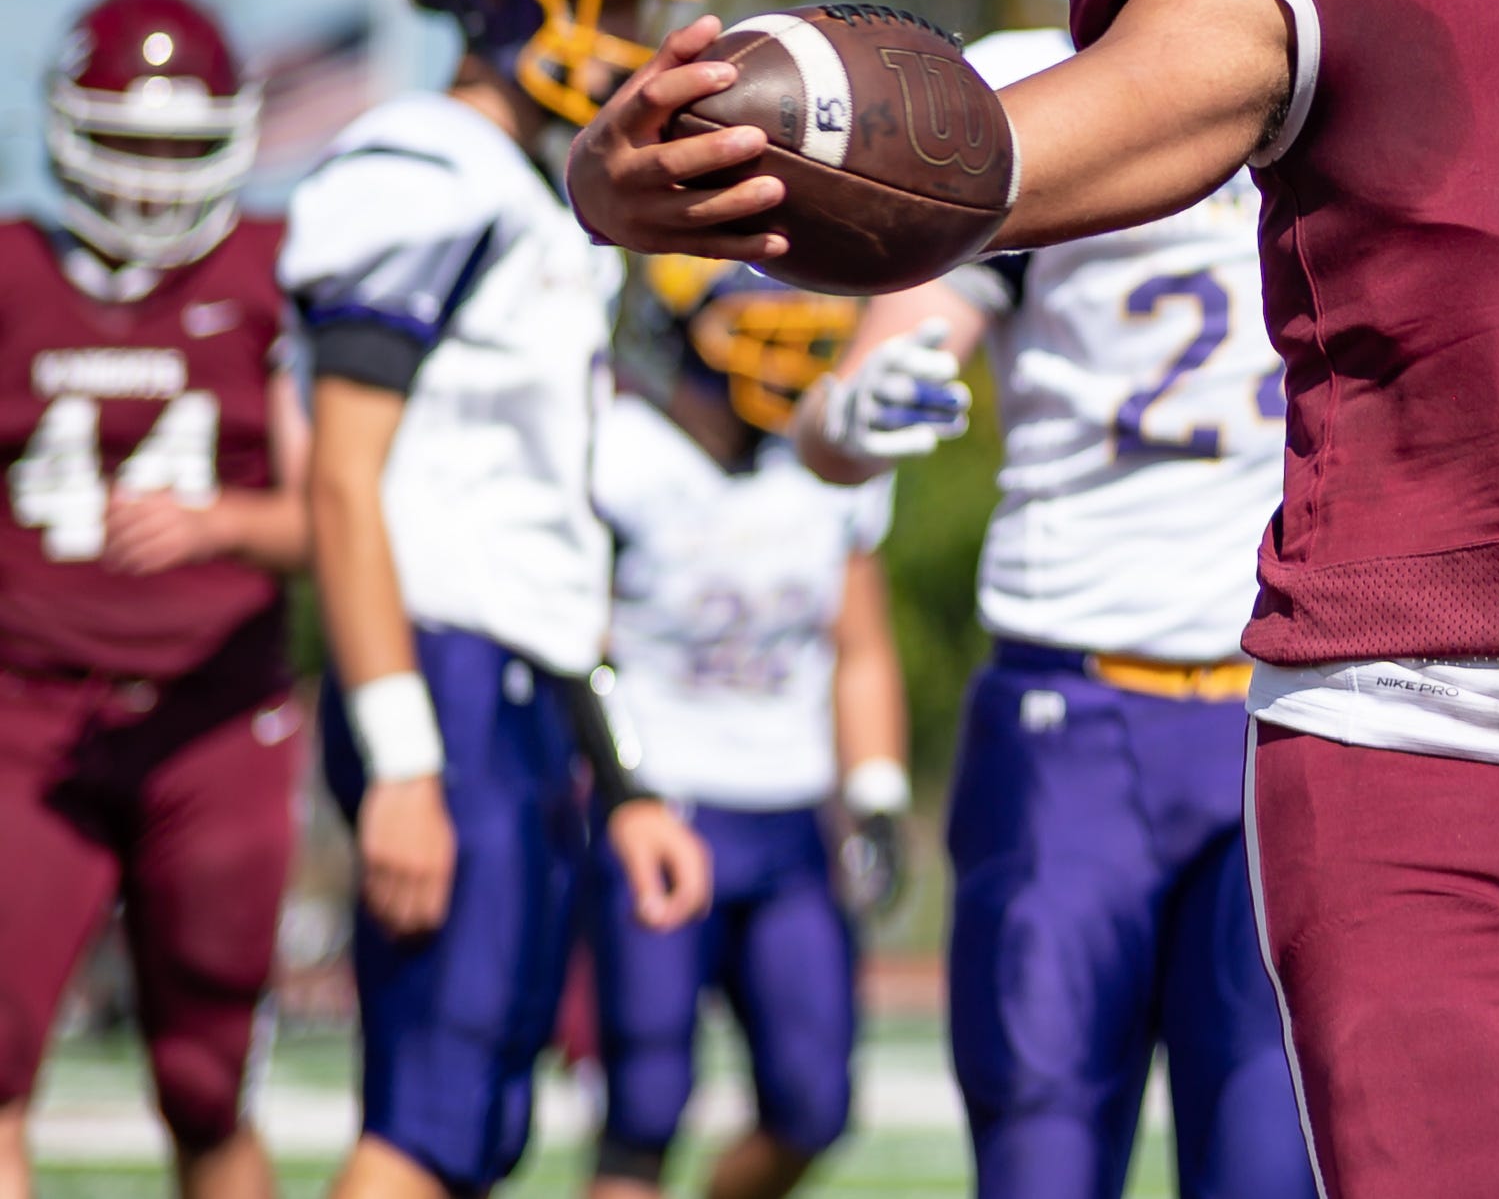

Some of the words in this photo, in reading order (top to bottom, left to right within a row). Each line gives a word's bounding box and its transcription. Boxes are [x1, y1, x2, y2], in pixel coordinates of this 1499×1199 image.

[1112, 265, 1287, 463] 2
[7, 389, 221, 562] 44
[1376, 677, 1417, 691] NIKE
[1419, 683, 1459, 697] PRO
